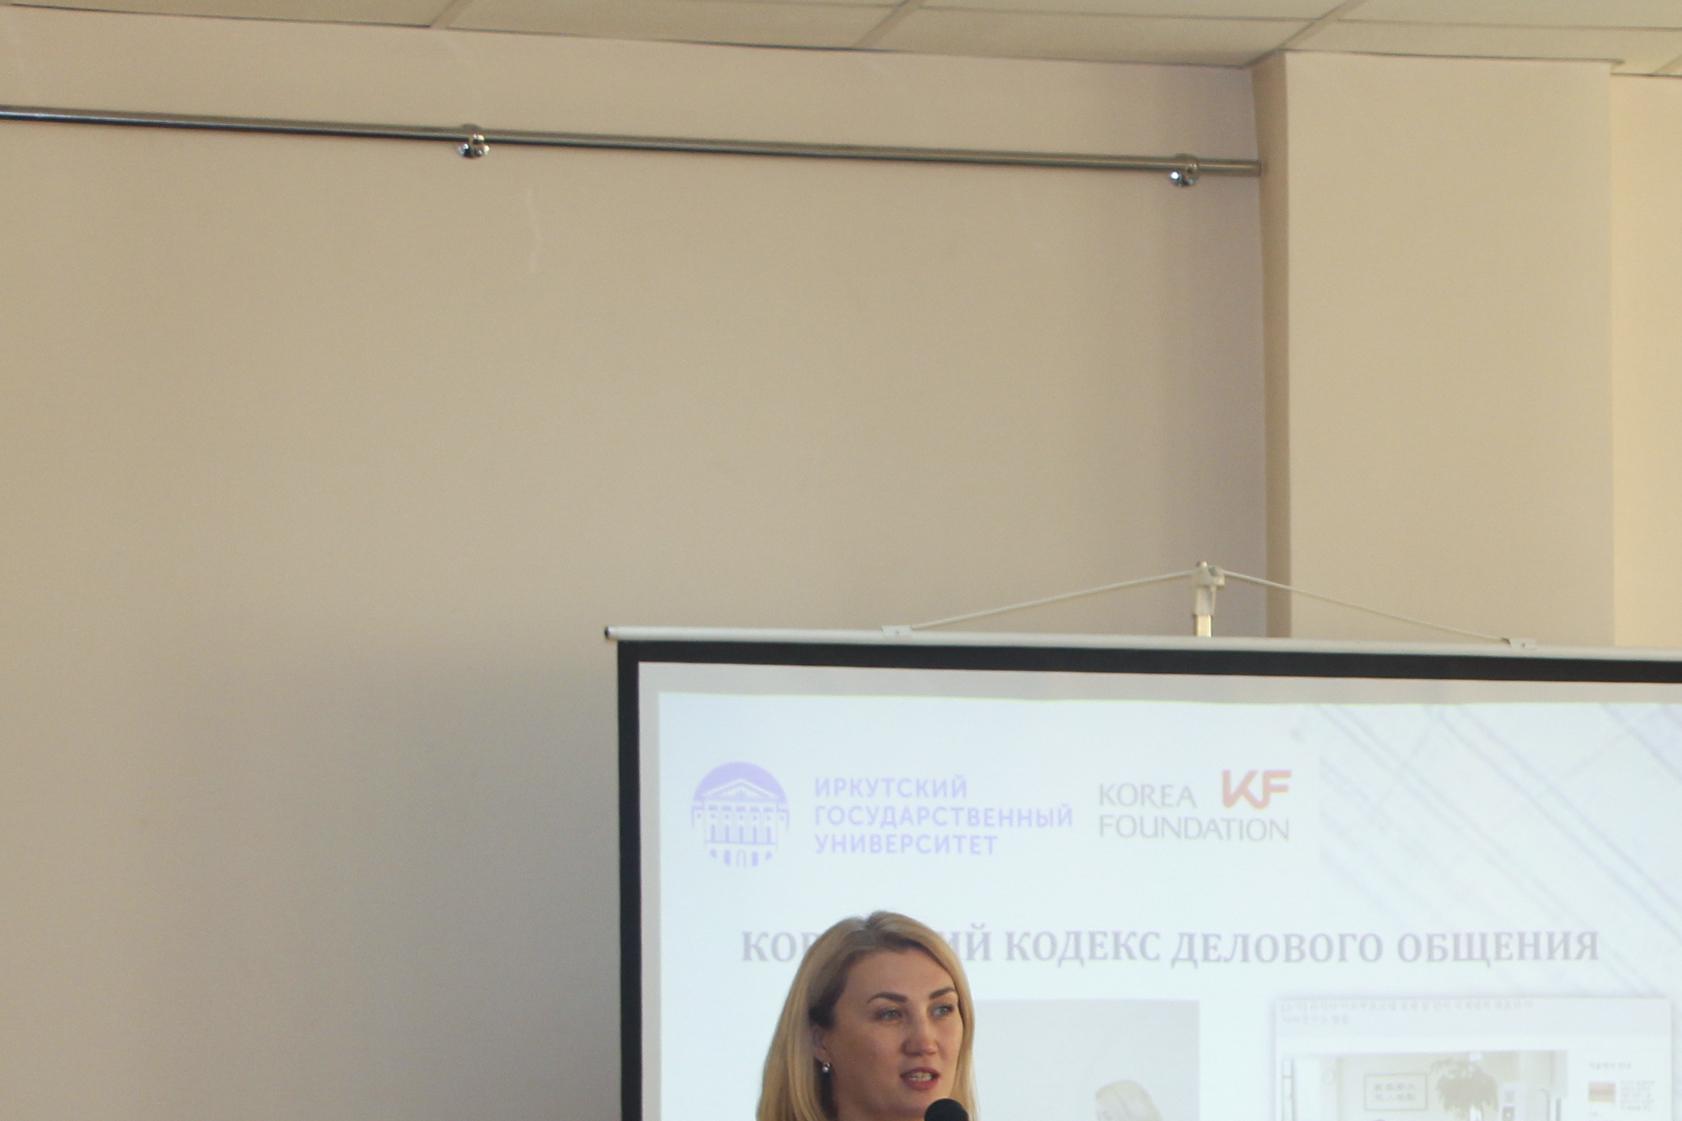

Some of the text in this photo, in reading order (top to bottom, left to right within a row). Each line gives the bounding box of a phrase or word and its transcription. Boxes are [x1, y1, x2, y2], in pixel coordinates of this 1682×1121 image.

[814, 773, 968, 800] ИРКУТСКИЙ
[1098, 782, 1198, 810] KOREA
[1221, 770, 1292, 811] KF
[813, 802, 1073, 830] ГОСУДАРСТВЕННЫЙ
[1098, 812, 1290, 843] FOUNDATION
[813, 834, 998, 857] УНИВЕРСИТЕТ
[1005, 930, 1161, 969] КОДЕКС
[1170, 931, 1384, 971] ДЕЛОВОГО
[1396, 930, 1600, 969] ОБЩЕНИЯ
